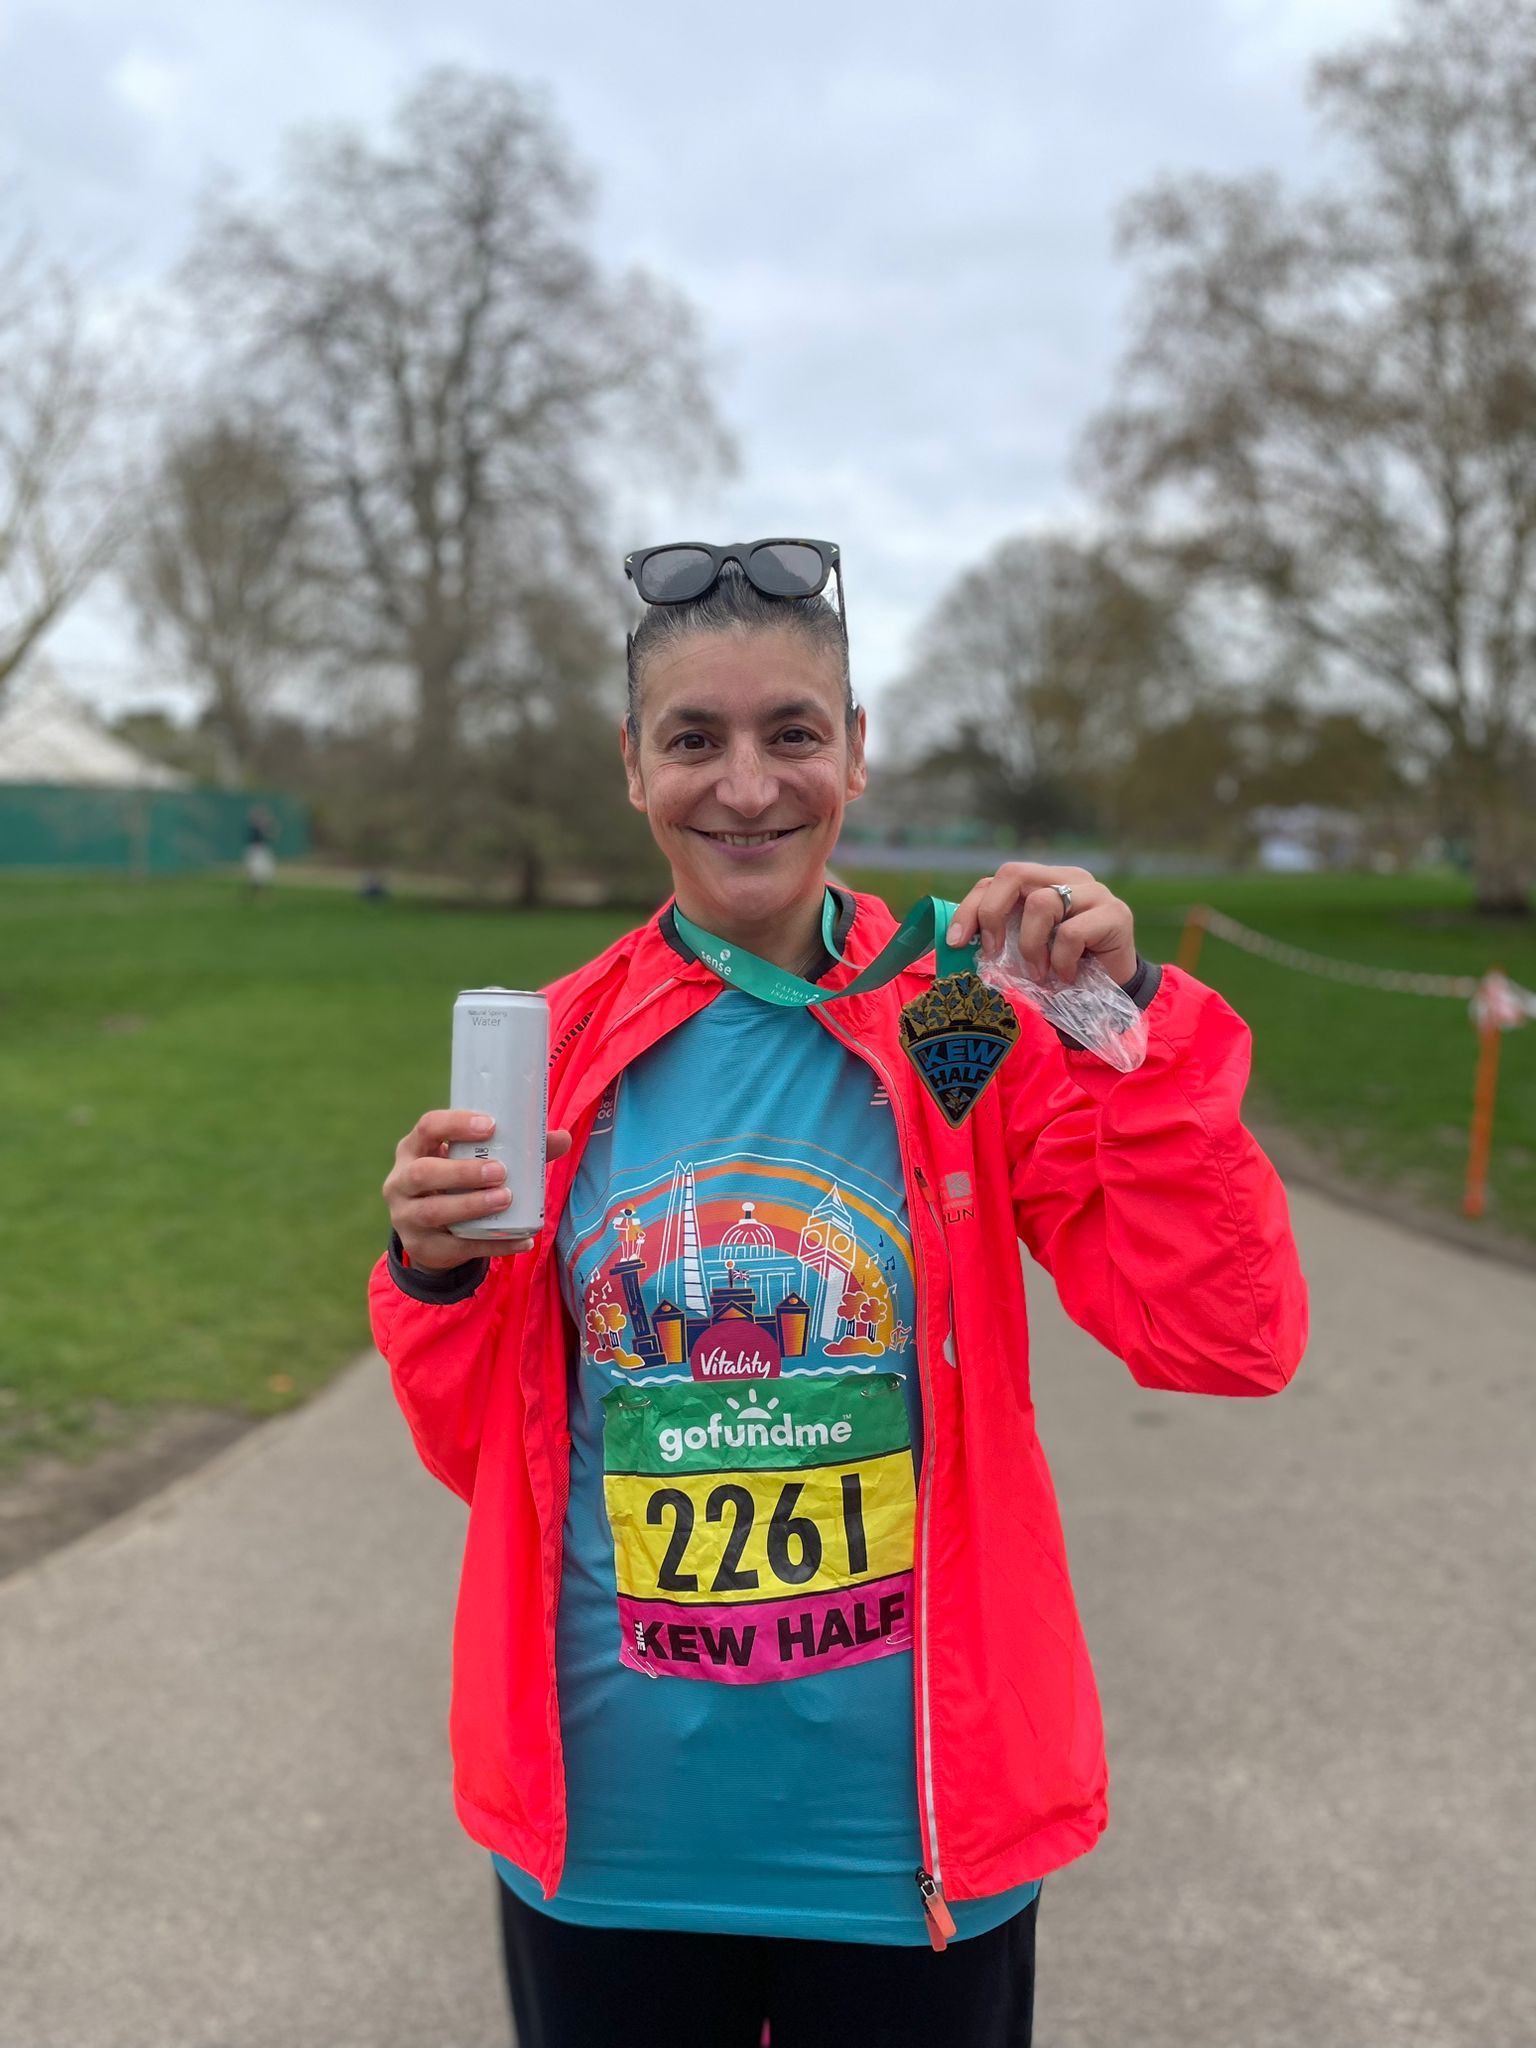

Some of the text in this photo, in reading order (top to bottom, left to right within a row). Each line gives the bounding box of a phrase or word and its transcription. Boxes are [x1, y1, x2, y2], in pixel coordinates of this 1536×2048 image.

[701, 950, 732, 976] sense
[472, 1016, 501, 1027] Water
[916, 1039, 1001, 1070] KEW
[929, 1067, 991, 1089] HALF
[700, 1346, 771, 1379] Vitality
[658, 1413, 852, 1462] gofundme
[646, 1473, 868, 1592] 2261
[634, 1591, 905, 1667] KEW HALF
[634, 1621, 647, 1651] THE
